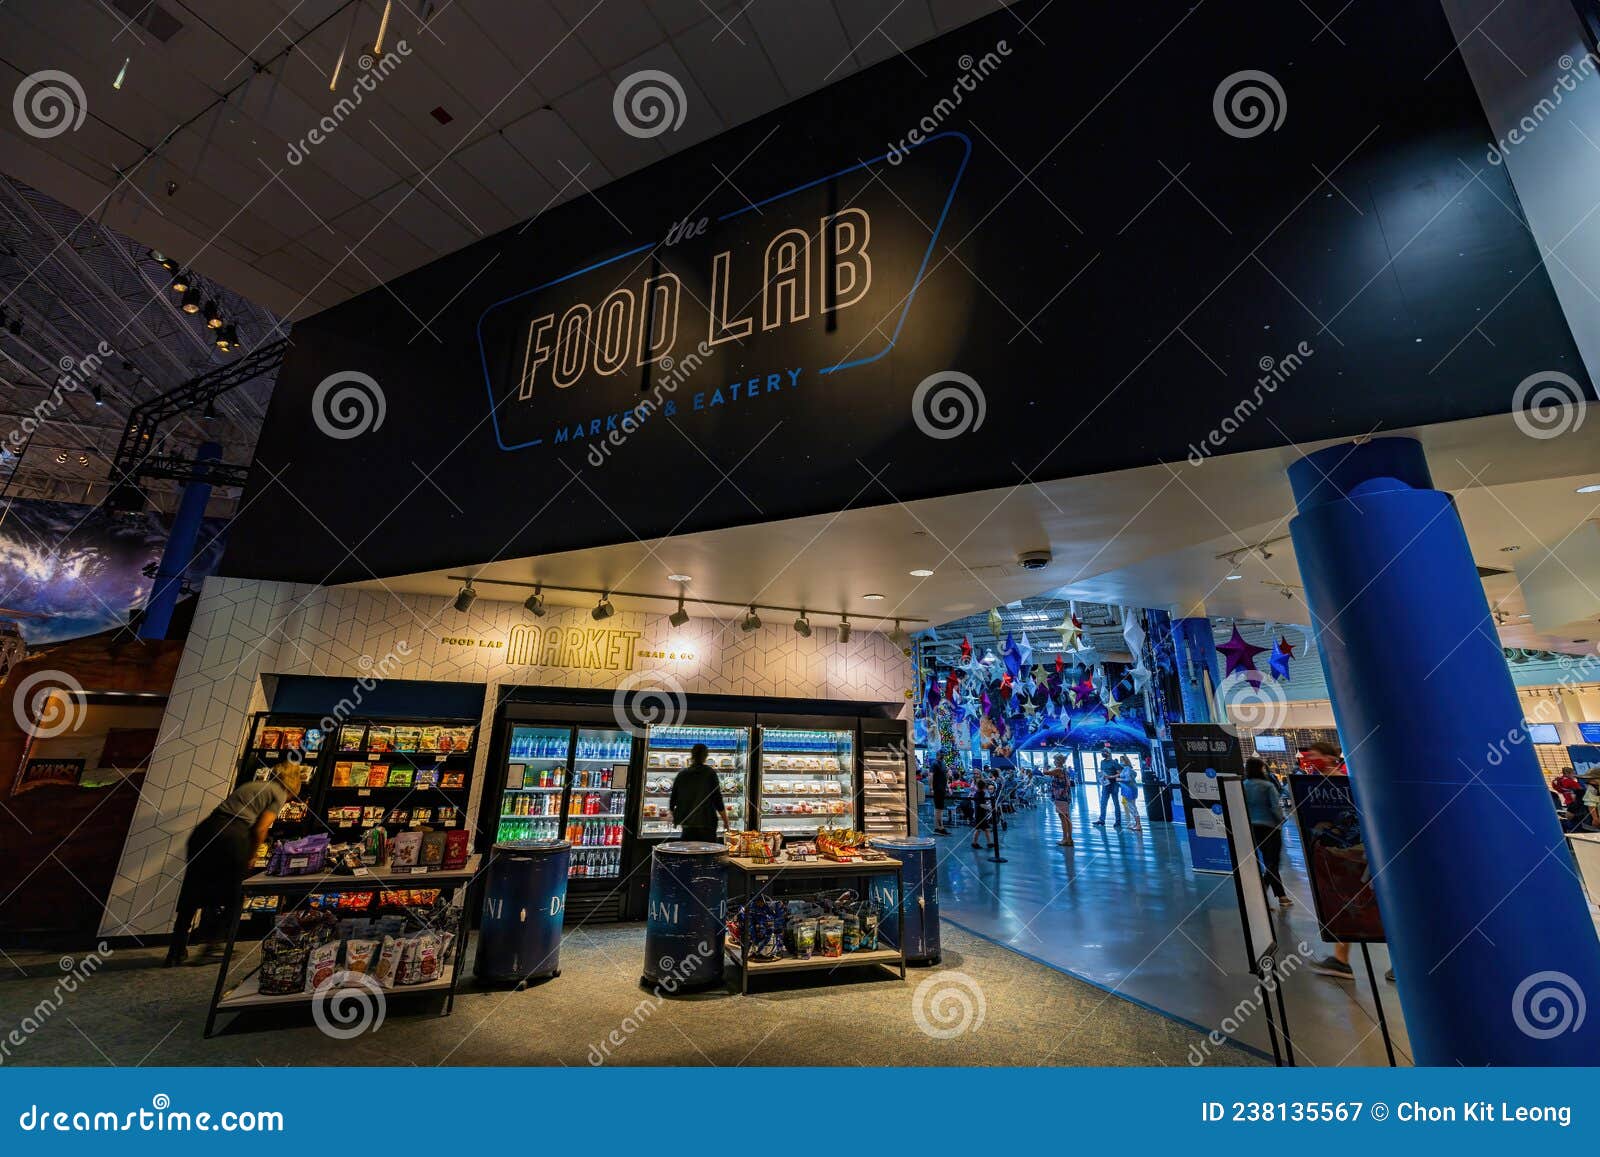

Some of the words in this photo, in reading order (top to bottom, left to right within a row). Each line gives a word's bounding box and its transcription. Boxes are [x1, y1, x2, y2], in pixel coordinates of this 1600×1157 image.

[665, 216, 709, 248] the
[519, 272, 680, 402] FOOD
[707, 207, 872, 346] LAB
[554, 407, 650, 445] MARKET
[663, 401, 677, 417] &
[693, 368, 804, 411] EATERY
[441, 637, 475, 649] FOOD
[479, 639, 504, 649] LAB
[506, 623, 642, 671] MARKET
